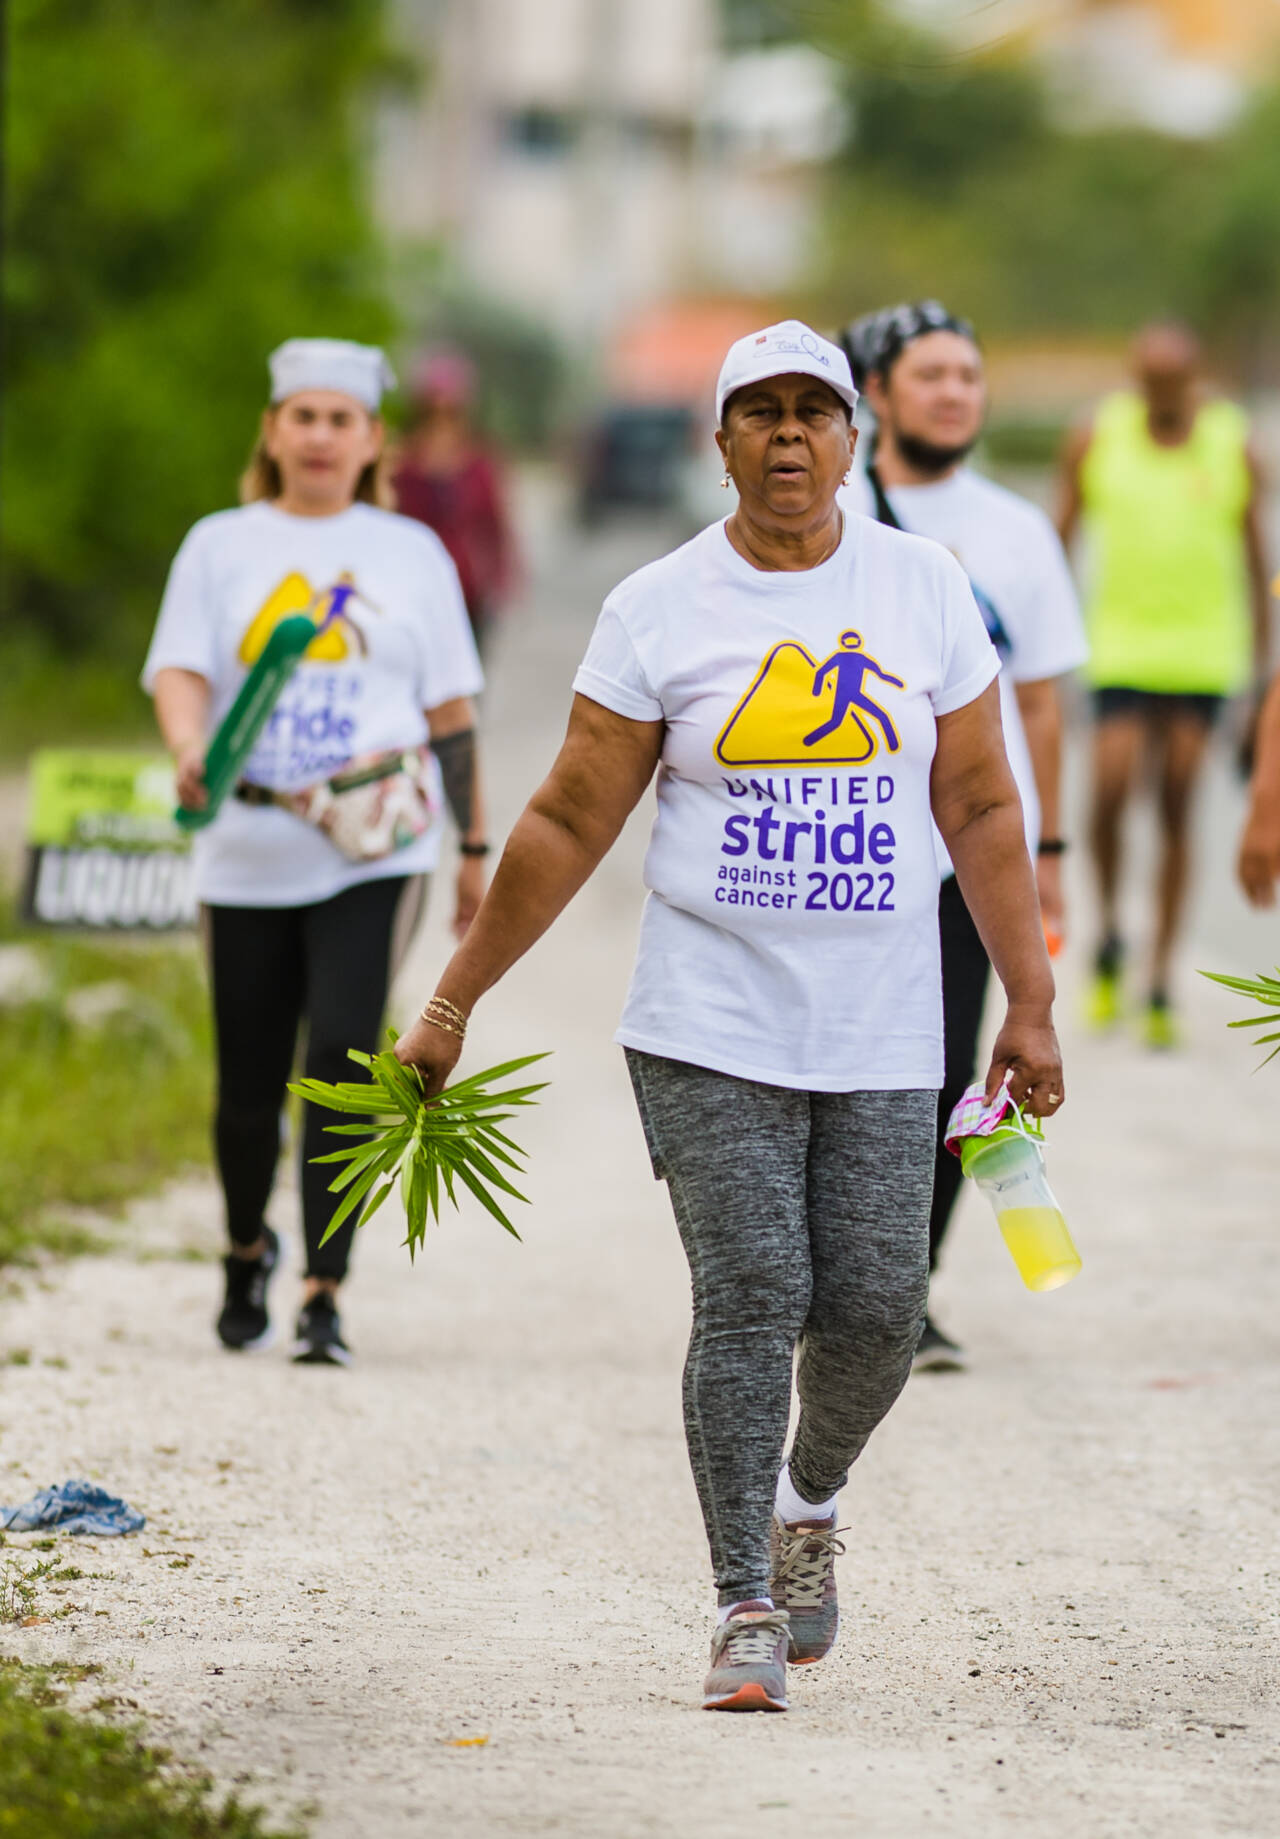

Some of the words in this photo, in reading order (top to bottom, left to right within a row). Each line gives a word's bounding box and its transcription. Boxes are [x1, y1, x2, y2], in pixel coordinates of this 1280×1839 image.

[722, 776, 895, 805] UNIFIED
[720, 806, 897, 866] stride
[714, 887, 798, 910] cancer
[804, 872, 895, 912] 2022
[717, 865, 797, 887] against
